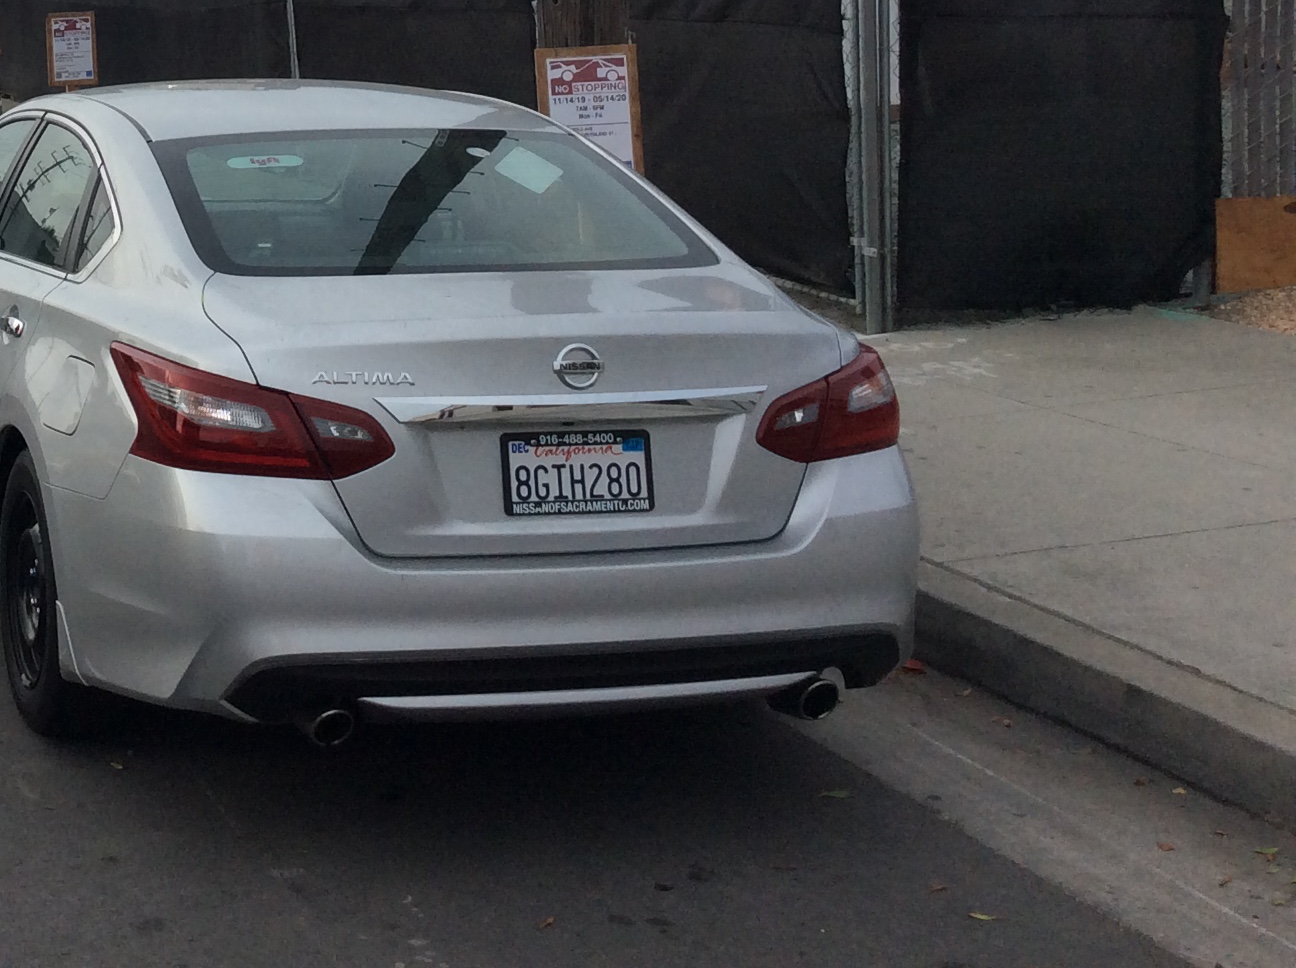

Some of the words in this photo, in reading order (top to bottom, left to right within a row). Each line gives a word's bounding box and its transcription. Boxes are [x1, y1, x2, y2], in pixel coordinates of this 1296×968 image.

[555, 84, 570, 94] NO
[572, 82, 625, 93] STOPPING
[552, 96, 586, 105] 11/14/19
[592, 94, 627, 103] 05/14/20
[559, 361, 601, 370] NISSAN
[311, 371, 415, 386] ALTIMA
[539, 433, 614, 445] 916-488-5400
[511, 443, 529, 453] DEC
[534, 444, 623, 462] California
[515, 462, 642, 501] 8GIH280
